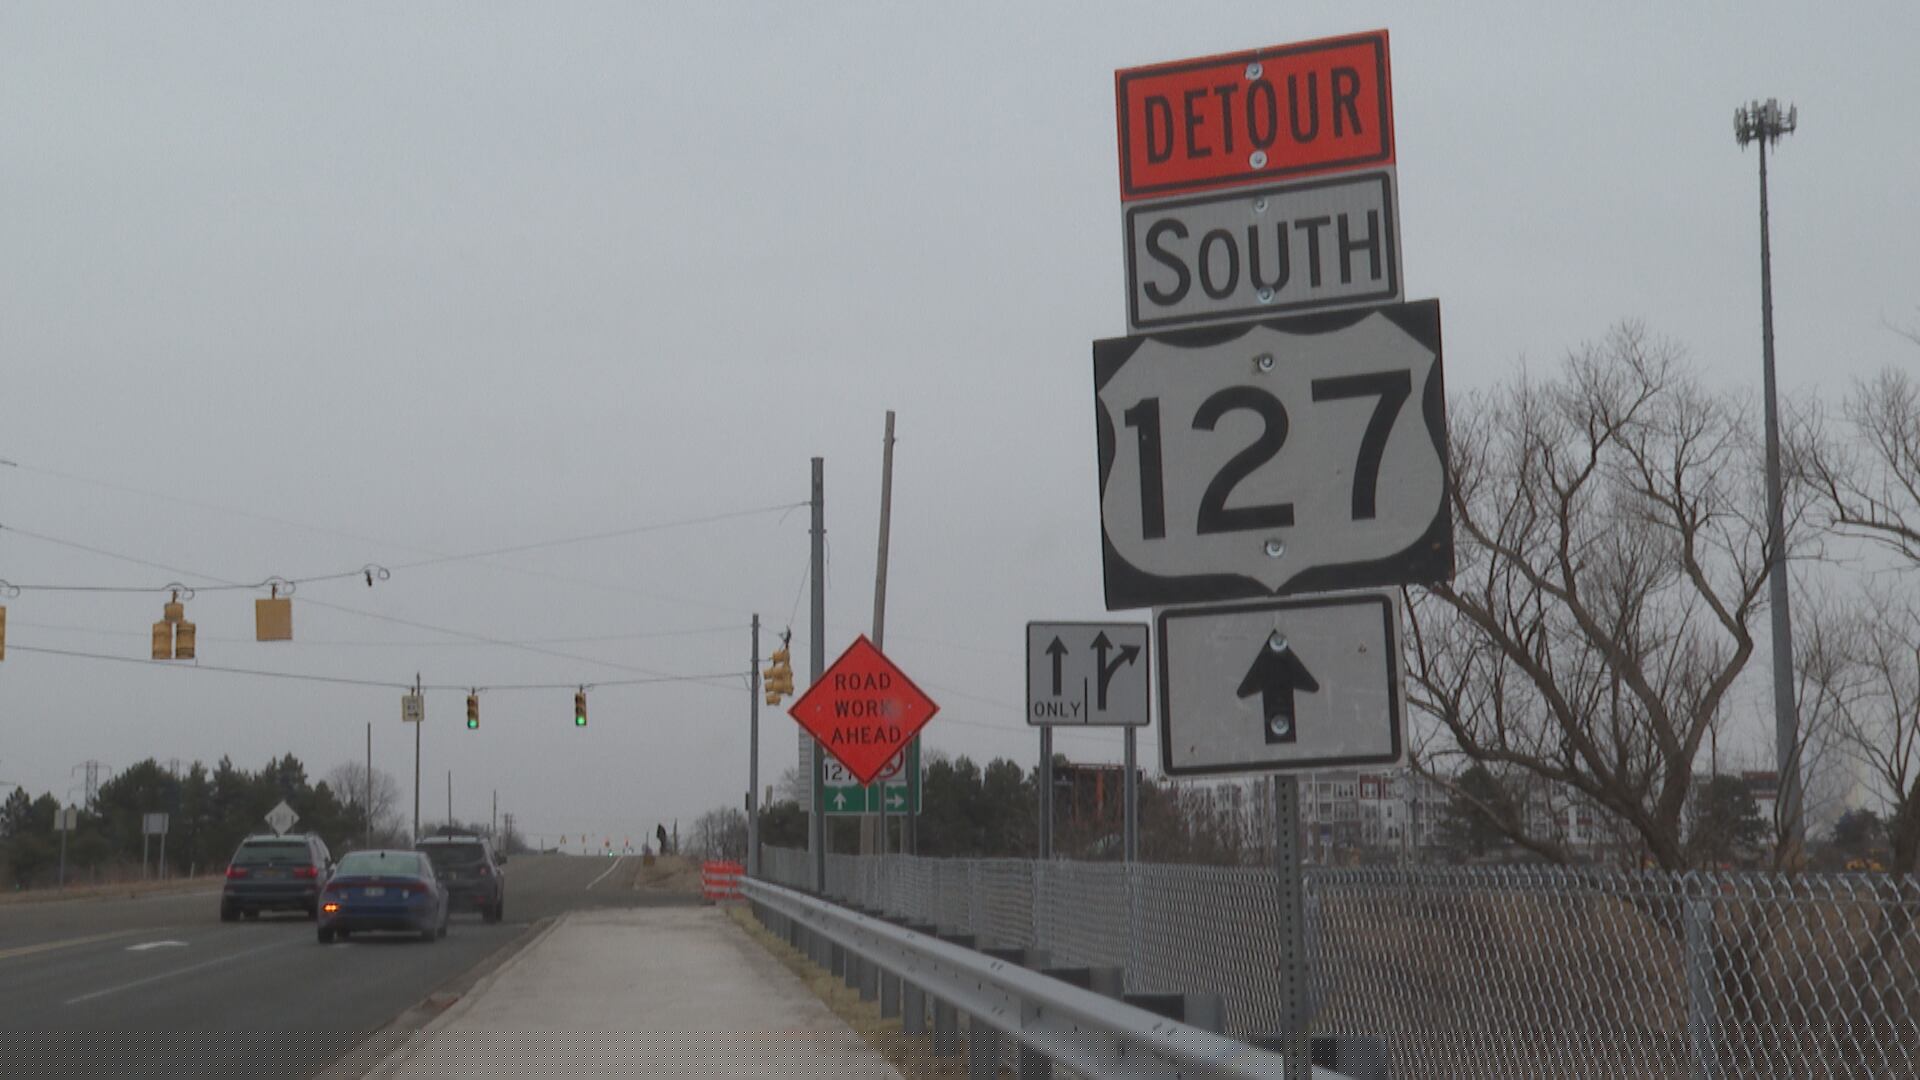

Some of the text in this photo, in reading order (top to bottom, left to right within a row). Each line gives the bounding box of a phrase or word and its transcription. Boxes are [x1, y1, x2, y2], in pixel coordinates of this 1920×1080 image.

[1143, 66, 1363, 165] DETOUR
[1143, 208, 1383, 306] SOUTH
[1124, 368, 1413, 541] 127
[834, 672, 892, 691] ROAD
[1034, 701, 1081, 718] ONLY
[831, 726, 901, 745] AHEAD
